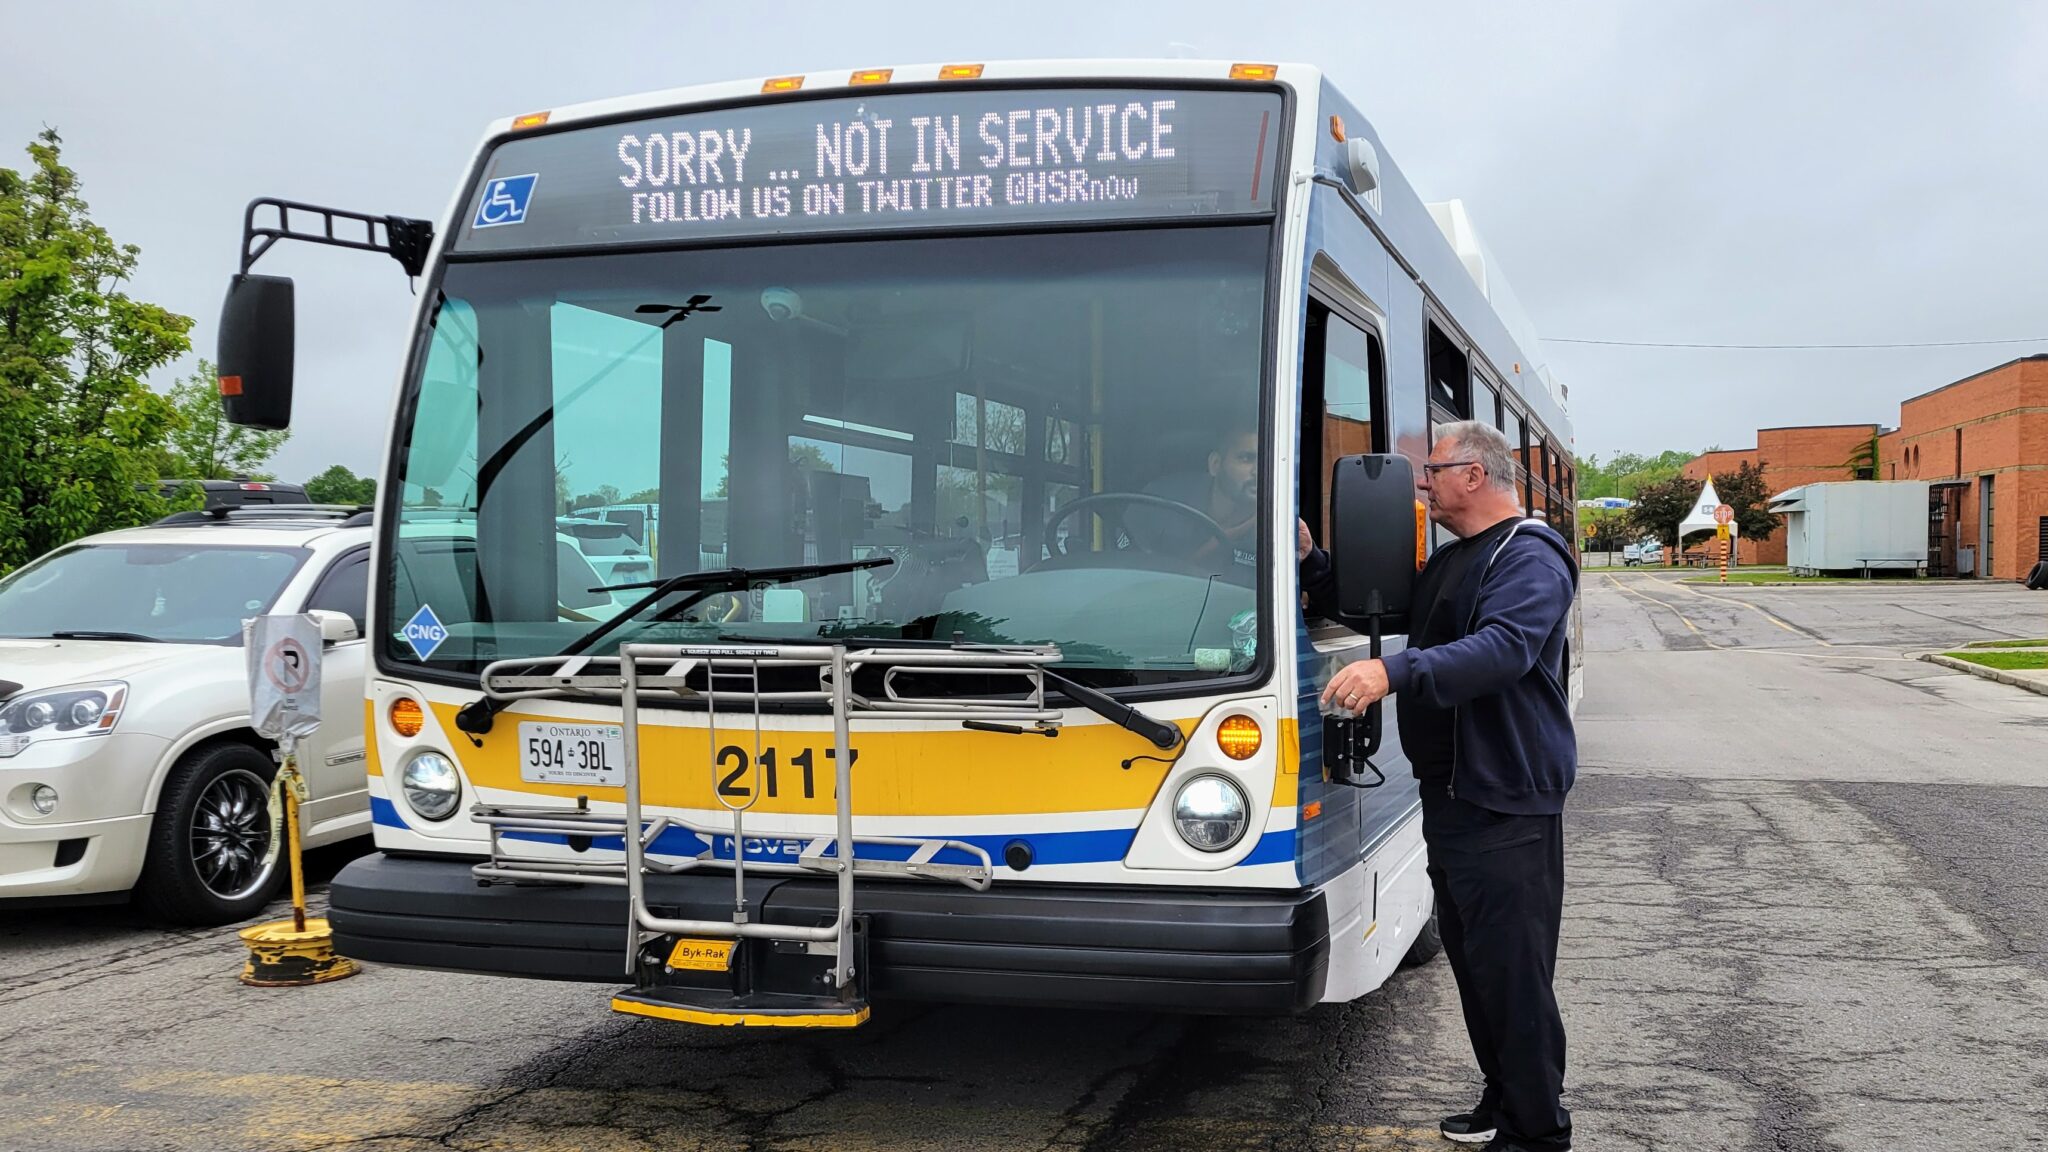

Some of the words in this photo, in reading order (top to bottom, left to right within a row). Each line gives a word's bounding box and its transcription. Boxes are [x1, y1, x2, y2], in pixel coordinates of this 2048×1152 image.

[618, 128, 752, 188] SORRY
[816, 119, 893, 178] NOT
[911, 115, 960, 172] IN
[979, 100, 1176, 168] SERVICE
[632, 188, 742, 224] FOLLOW
[752, 186, 791, 218] US
[802, 183, 845, 216] ON
[857, 174, 993, 213] TWITTER
[1006, 169, 1138, 207] @HSRnow
[1714, 511, 1733, 519] STOP
[407, 624, 442, 641] CNG
[550, 727, 591, 737] ONTARIO
[529, 738, 564, 768] 594
[577, 741, 613, 771] 3BL
[682, 947, 725, 959] Byk-Rak
